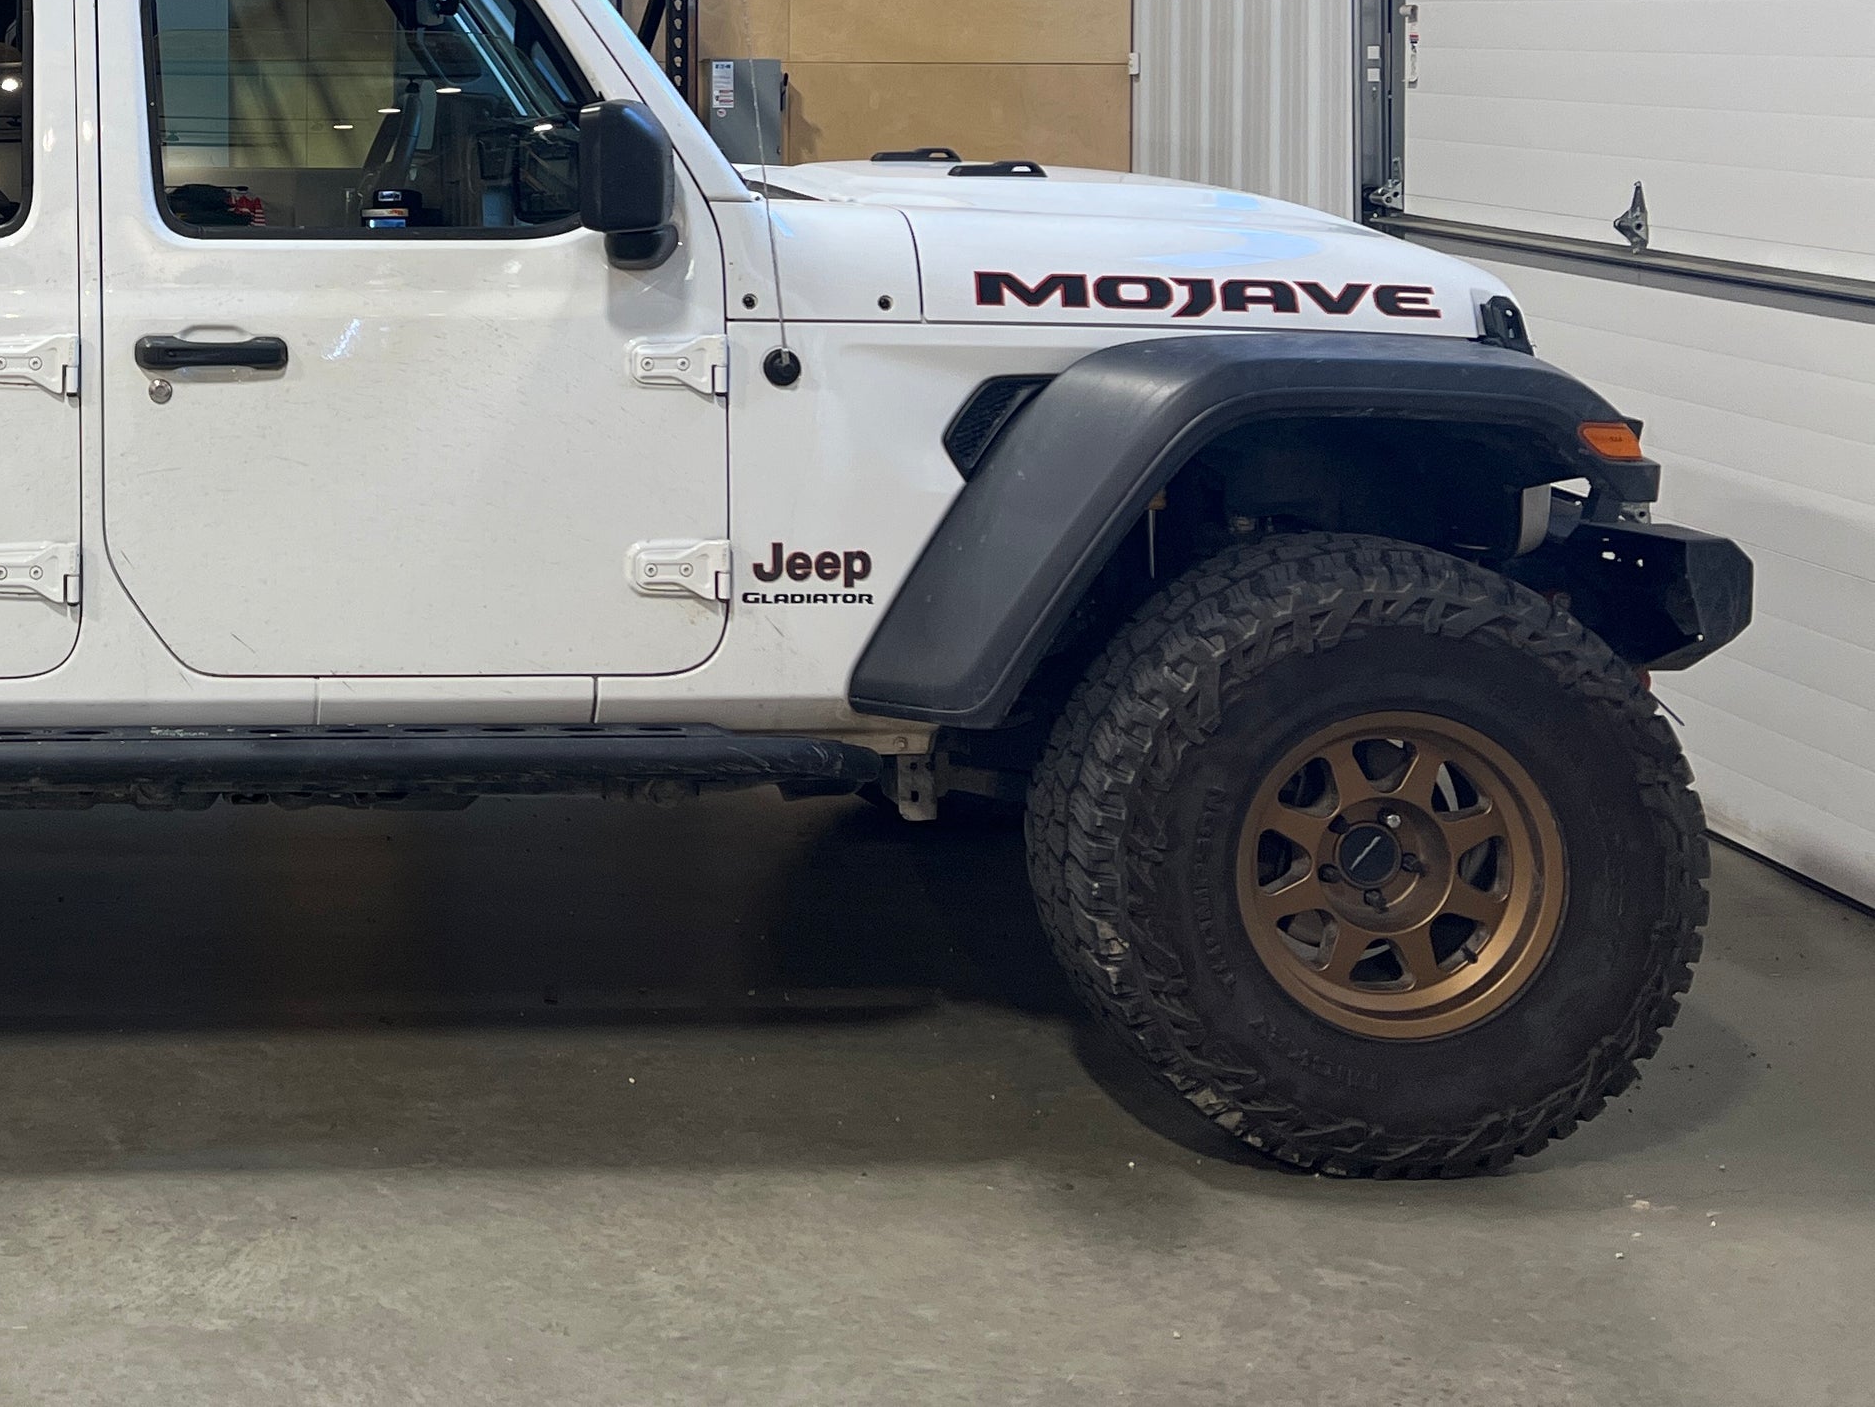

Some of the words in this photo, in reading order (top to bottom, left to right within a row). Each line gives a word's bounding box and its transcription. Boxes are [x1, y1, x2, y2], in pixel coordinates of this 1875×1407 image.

[973, 270, 1443, 320] MOJAVE
[752, 541, 872, 588] Jeep
[741, 592, 875, 605] GLADIATOR
